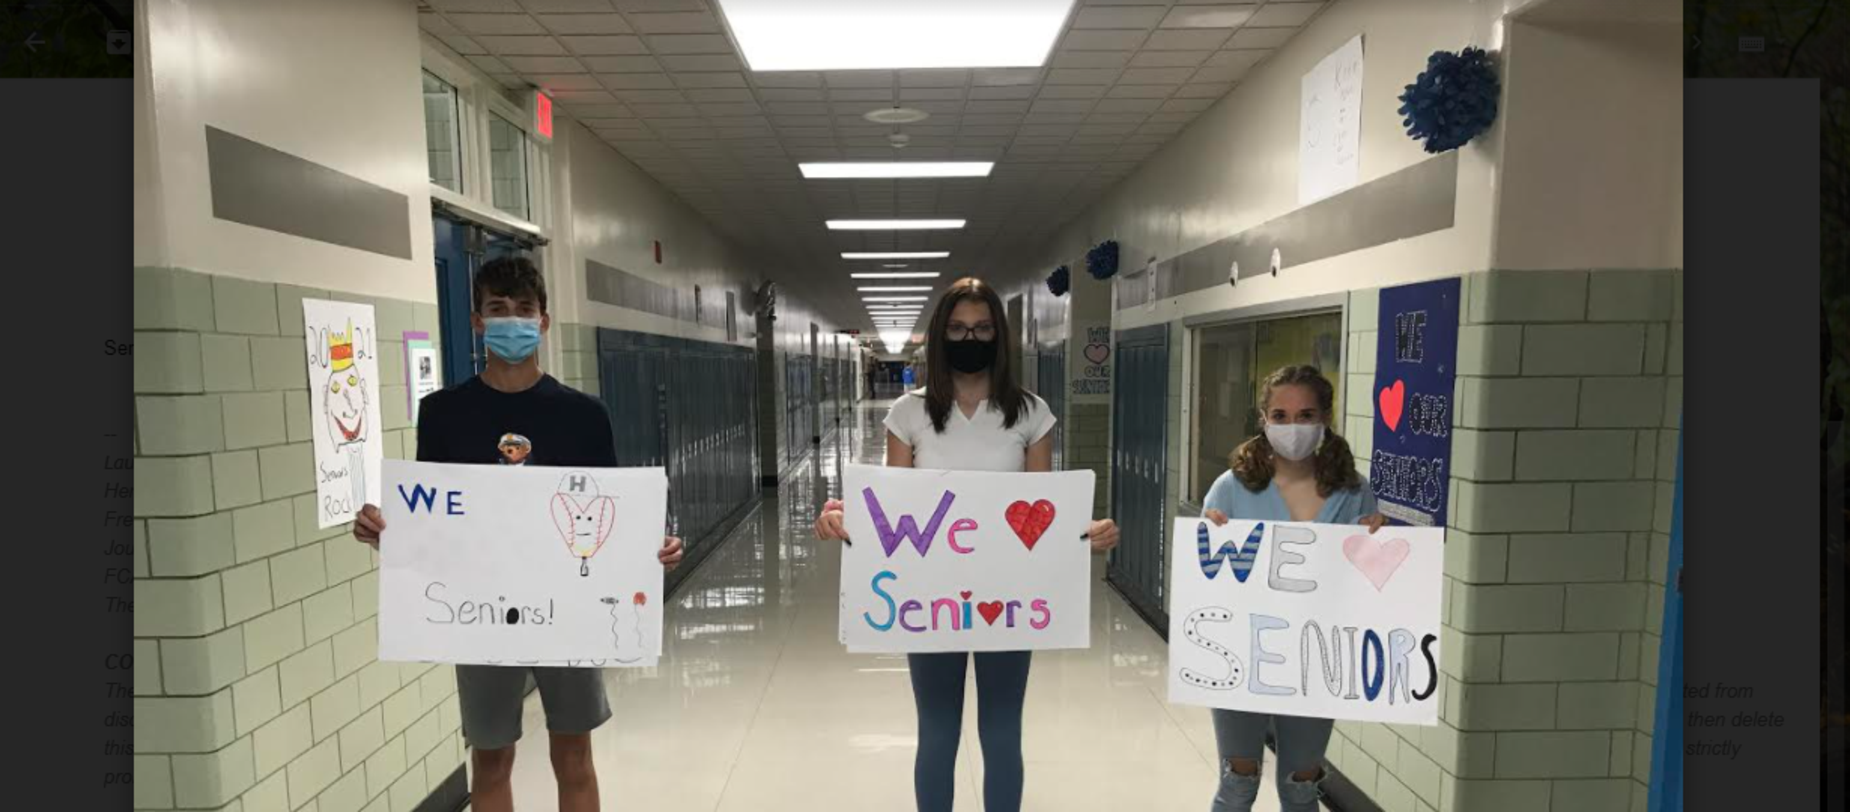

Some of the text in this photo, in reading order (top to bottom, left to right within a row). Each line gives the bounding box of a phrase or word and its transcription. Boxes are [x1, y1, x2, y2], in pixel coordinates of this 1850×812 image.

[1395, 309, 1428, 364] WE
[1408, 391, 1448, 438] OUR
[569, 475, 587, 493] H
[1371, 448, 1444, 513] SENIORS
[398, 483, 466, 516] WE
[104, 510, 134, 527] Fre
[862, 486, 979, 559] We
[1196, 521, 1318, 594] WE
[425, 581, 554, 626] Seniors!
[104, 653, 134, 670] CO
[1179, 605, 1438, 706] SENIORS
[1683, 682, 1754, 699] ted from
[1687, 710, 1785, 728] then delete
[104, 739, 134, 756] this
[1685, 739, 1743, 760] strictly
